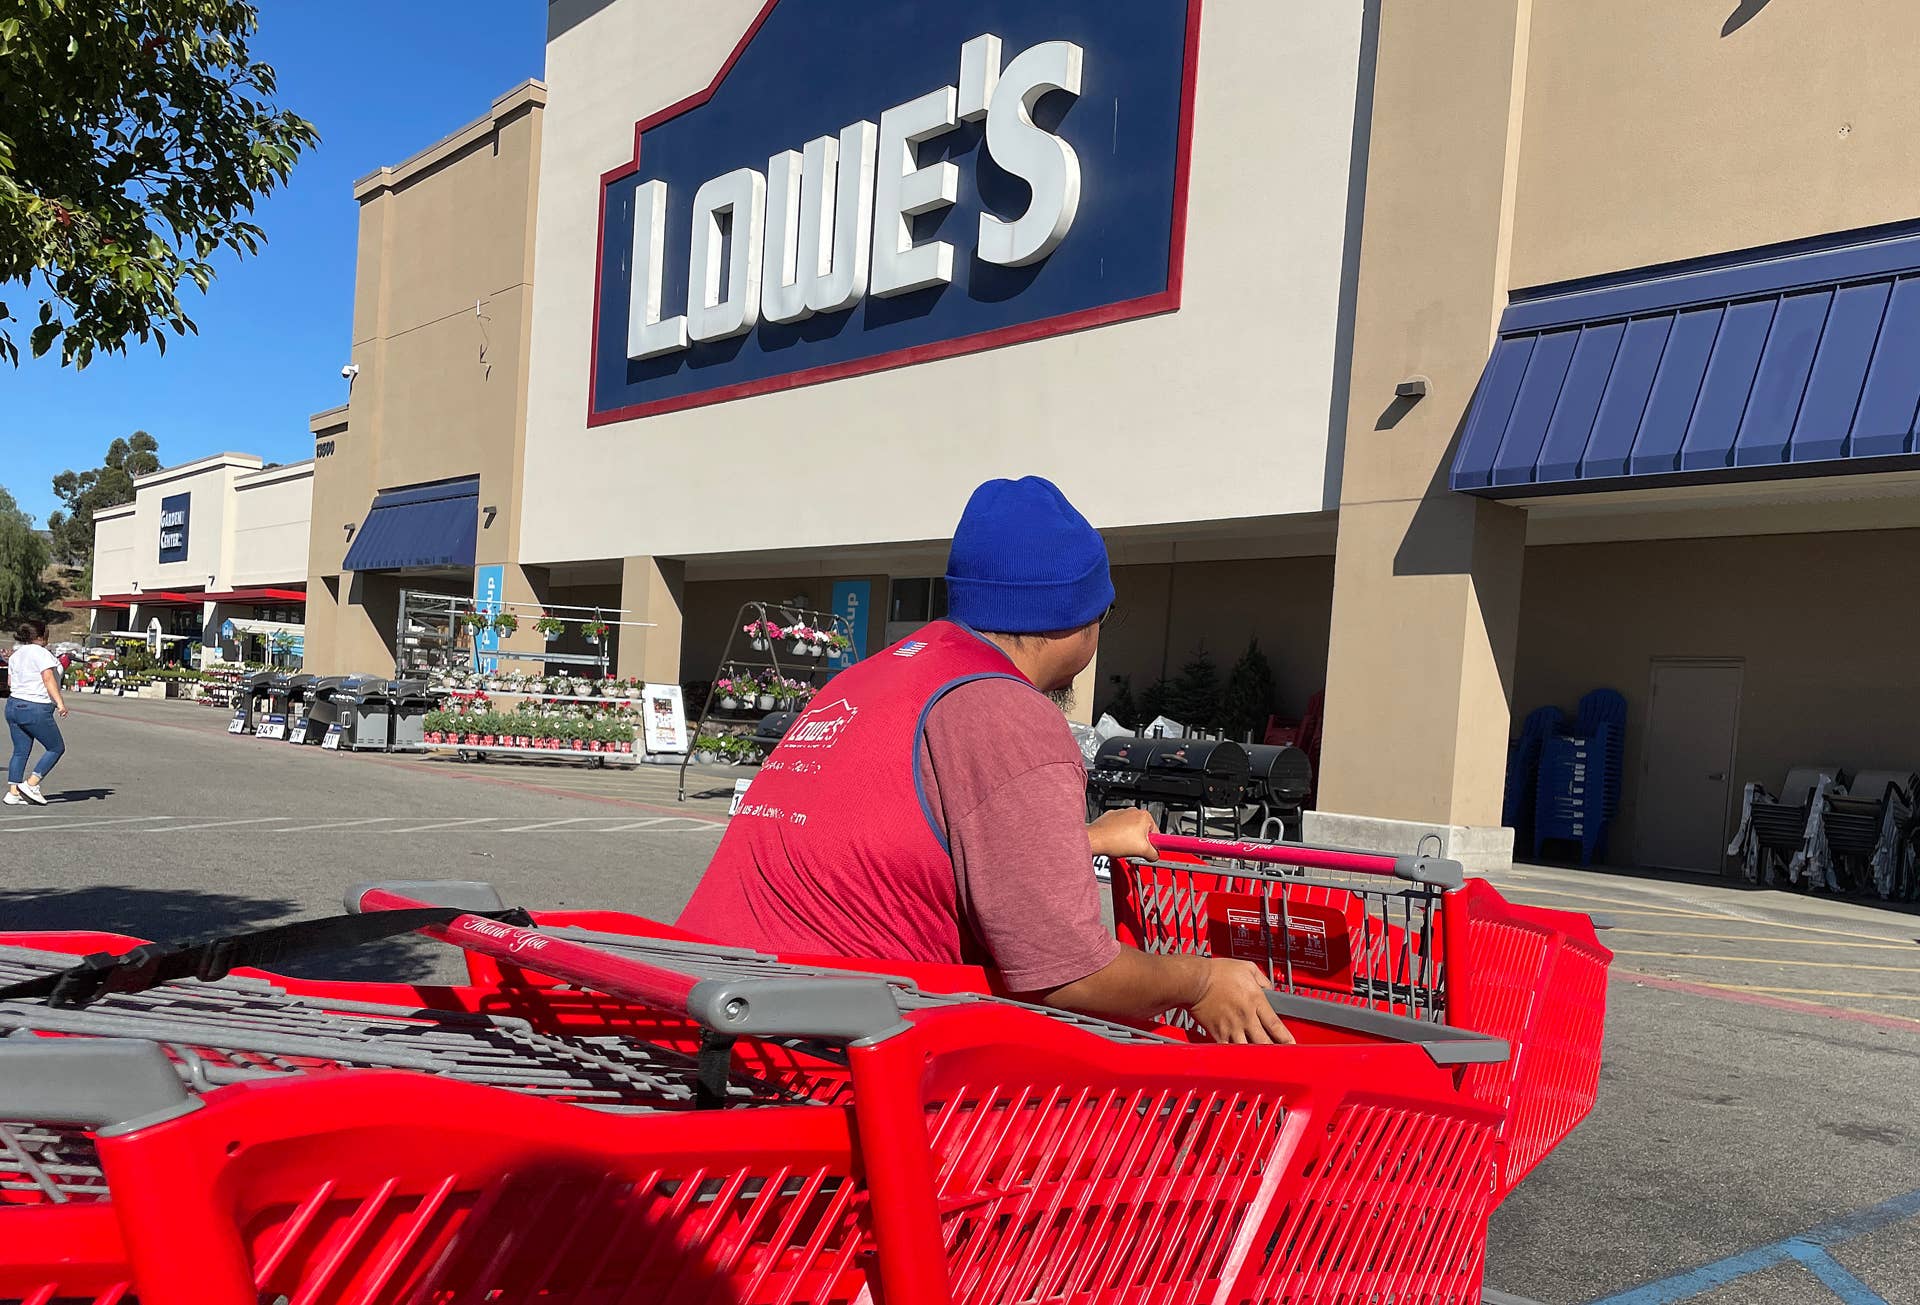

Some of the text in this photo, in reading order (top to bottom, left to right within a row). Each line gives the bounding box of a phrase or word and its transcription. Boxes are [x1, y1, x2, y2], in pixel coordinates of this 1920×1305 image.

[627, 33, 1084, 360] LOWE'S
[481, 577, 496, 646] Pkup
[841, 593, 859, 668] Pikup
[257, 725, 274, 736] 249
[463, 918, 550, 953] Thank You
